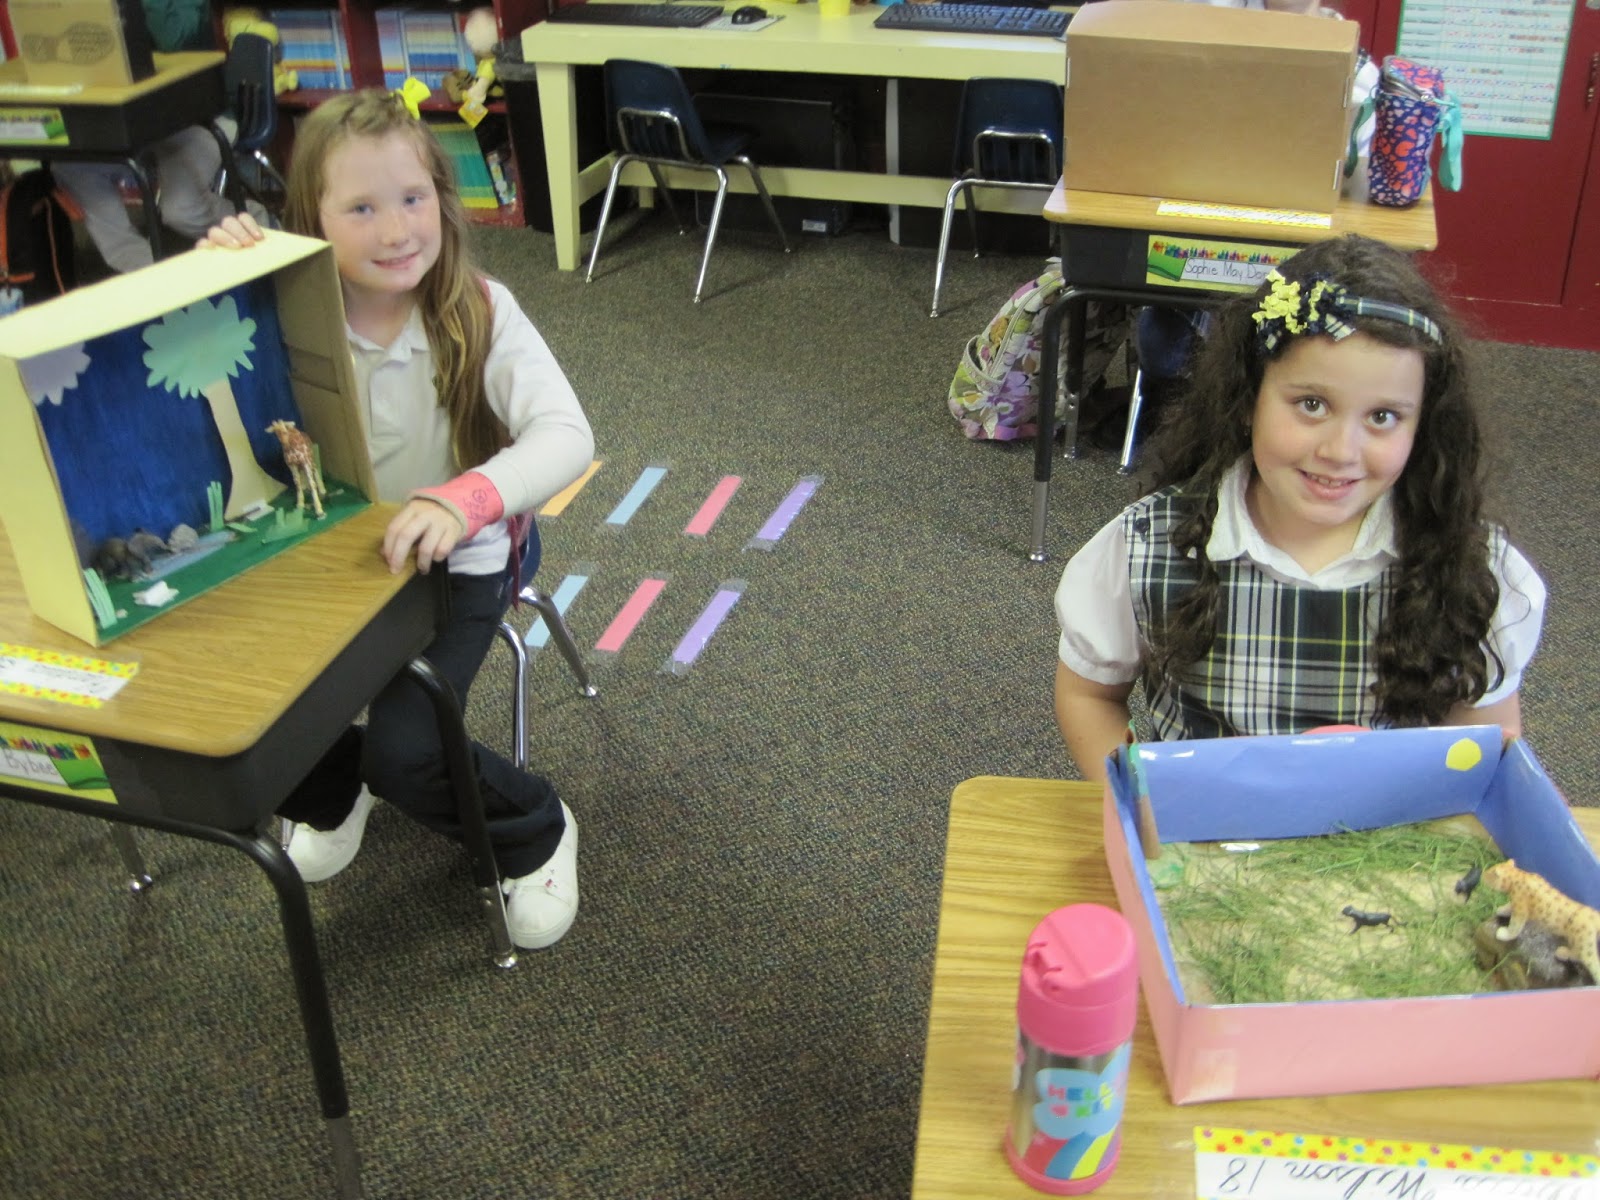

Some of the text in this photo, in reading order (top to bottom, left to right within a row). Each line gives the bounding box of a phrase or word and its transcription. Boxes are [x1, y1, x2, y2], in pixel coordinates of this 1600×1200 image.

[1184, 258, 1218, 279] Sophie
[1223, 261, 1243, 281] May
[1219, 1157, 1266, 1194] 18
[1284, 1161, 1436, 1200] Wilson
